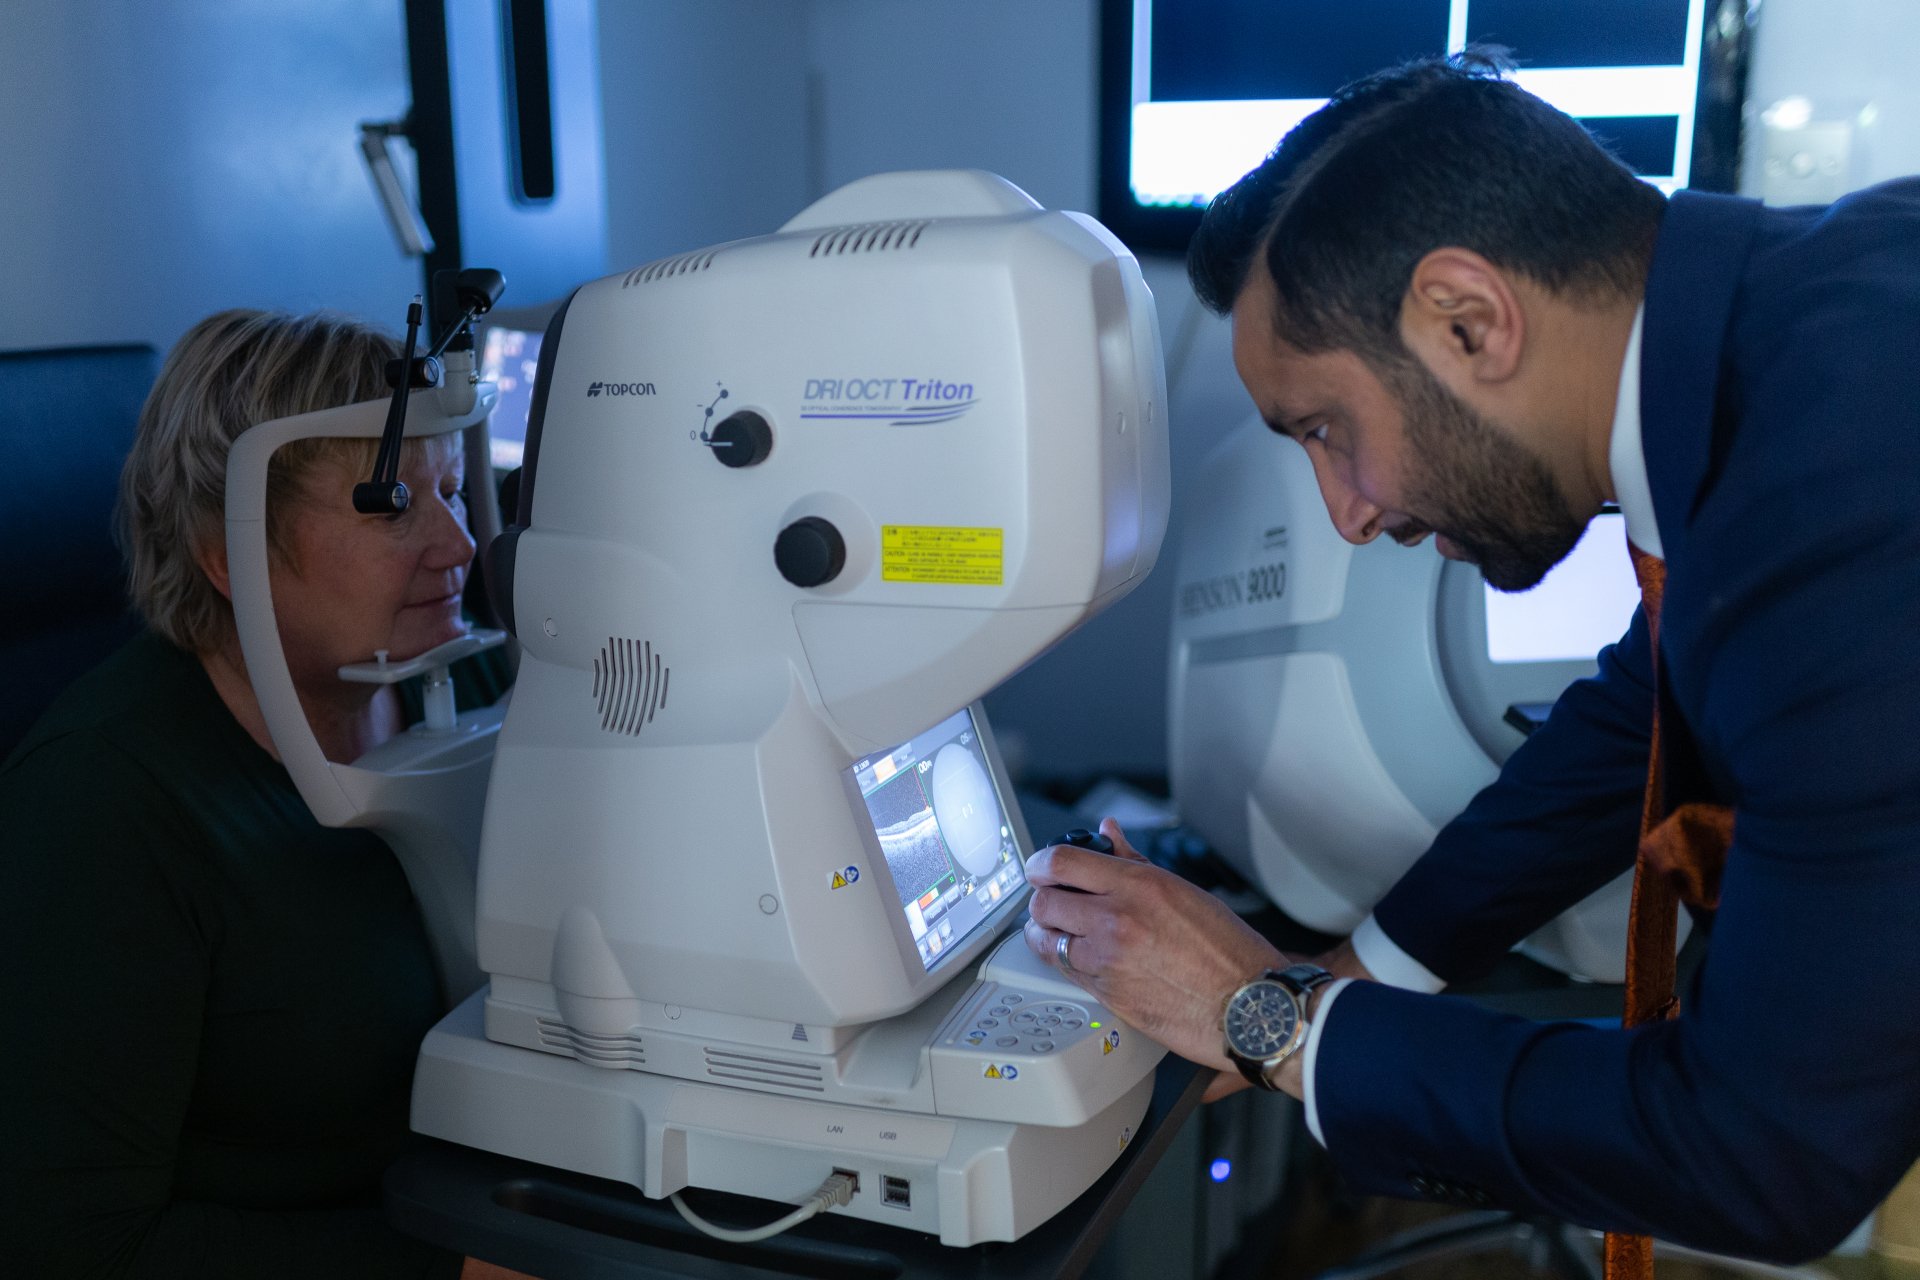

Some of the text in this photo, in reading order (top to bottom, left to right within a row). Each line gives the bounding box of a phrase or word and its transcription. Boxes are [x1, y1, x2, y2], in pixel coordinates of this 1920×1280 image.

[604, 383, 656, 396] TOPCON
[803, 379, 974, 400] DRI OCT Triton
[826, 1125, 844, 1134] LAN
[880, 1131, 897, 1140] USB
